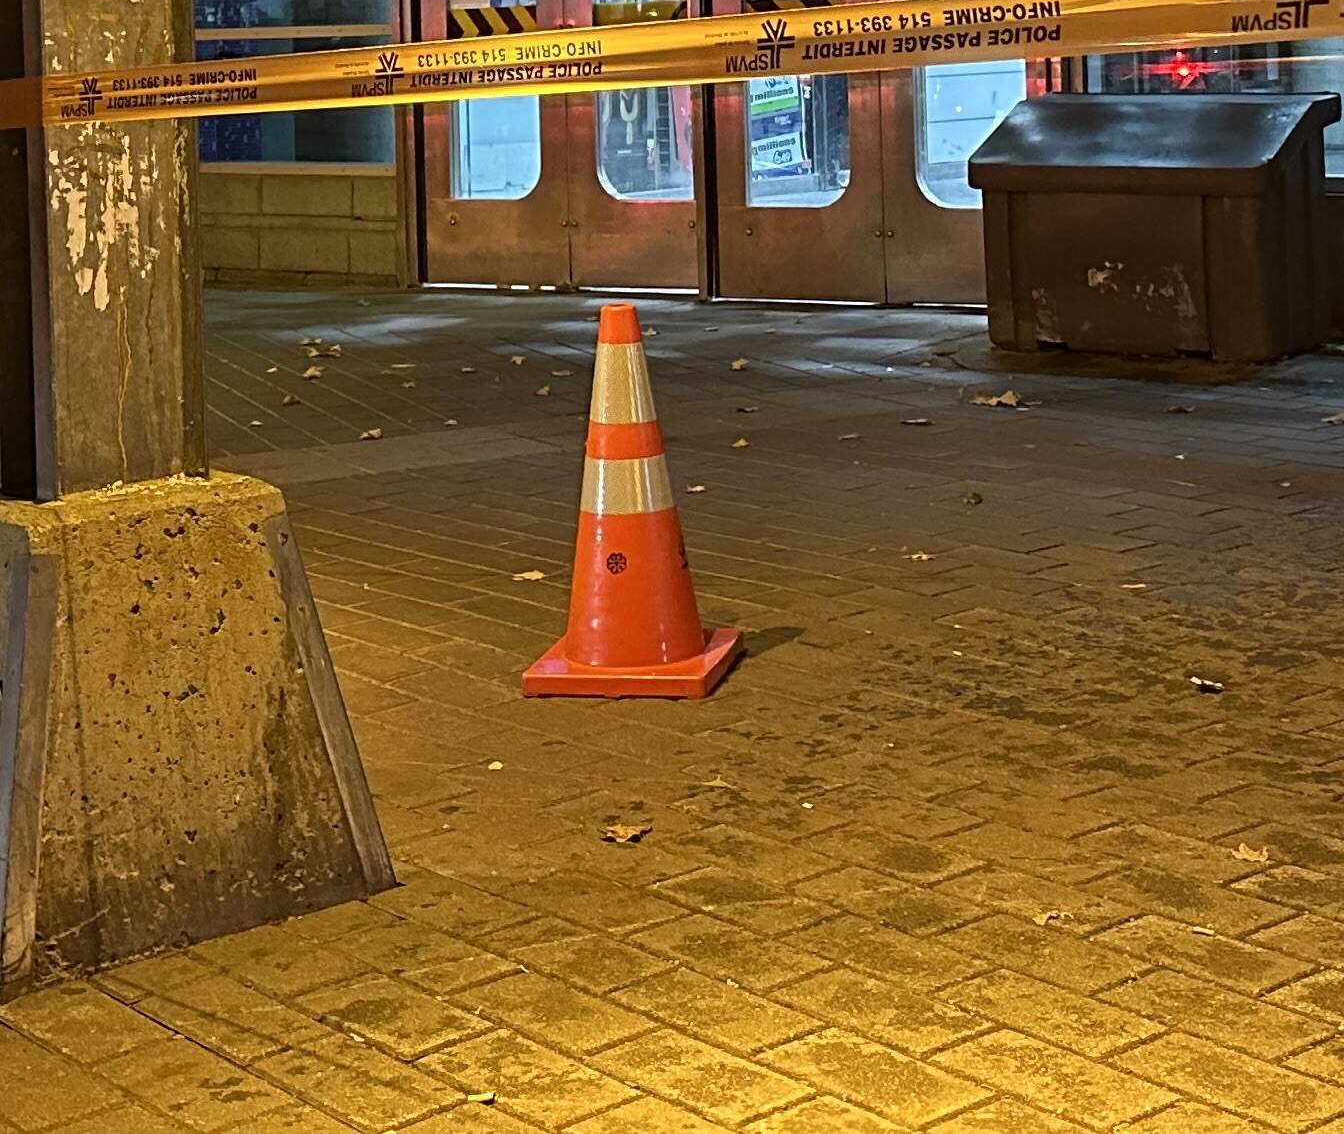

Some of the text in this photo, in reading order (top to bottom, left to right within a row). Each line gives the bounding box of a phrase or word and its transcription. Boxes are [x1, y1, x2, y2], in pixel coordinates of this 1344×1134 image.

[813, 0, 1061, 37] INFO-CRIME 514 393-1133
[1231, 11, 1291, 33] SPVM
[417, 39, 602, 67] INFO-CRIME 514 393-1133
[802, 24, 1061, 60] POLICE PASSAGE INTERDIT
[725, 52, 769, 73] SPVM
[112, 68, 257, 92] INFO-CRIME 514 393-1133
[409, 61, 603, 88] POLICE PASSAGE INTERDIT
[215, 87, 257, 102] POLICE
[351, 81, 385, 98] SPVM
[60, 103, 88, 118] SPVM
[106, 94, 155, 110] INTERDIT
